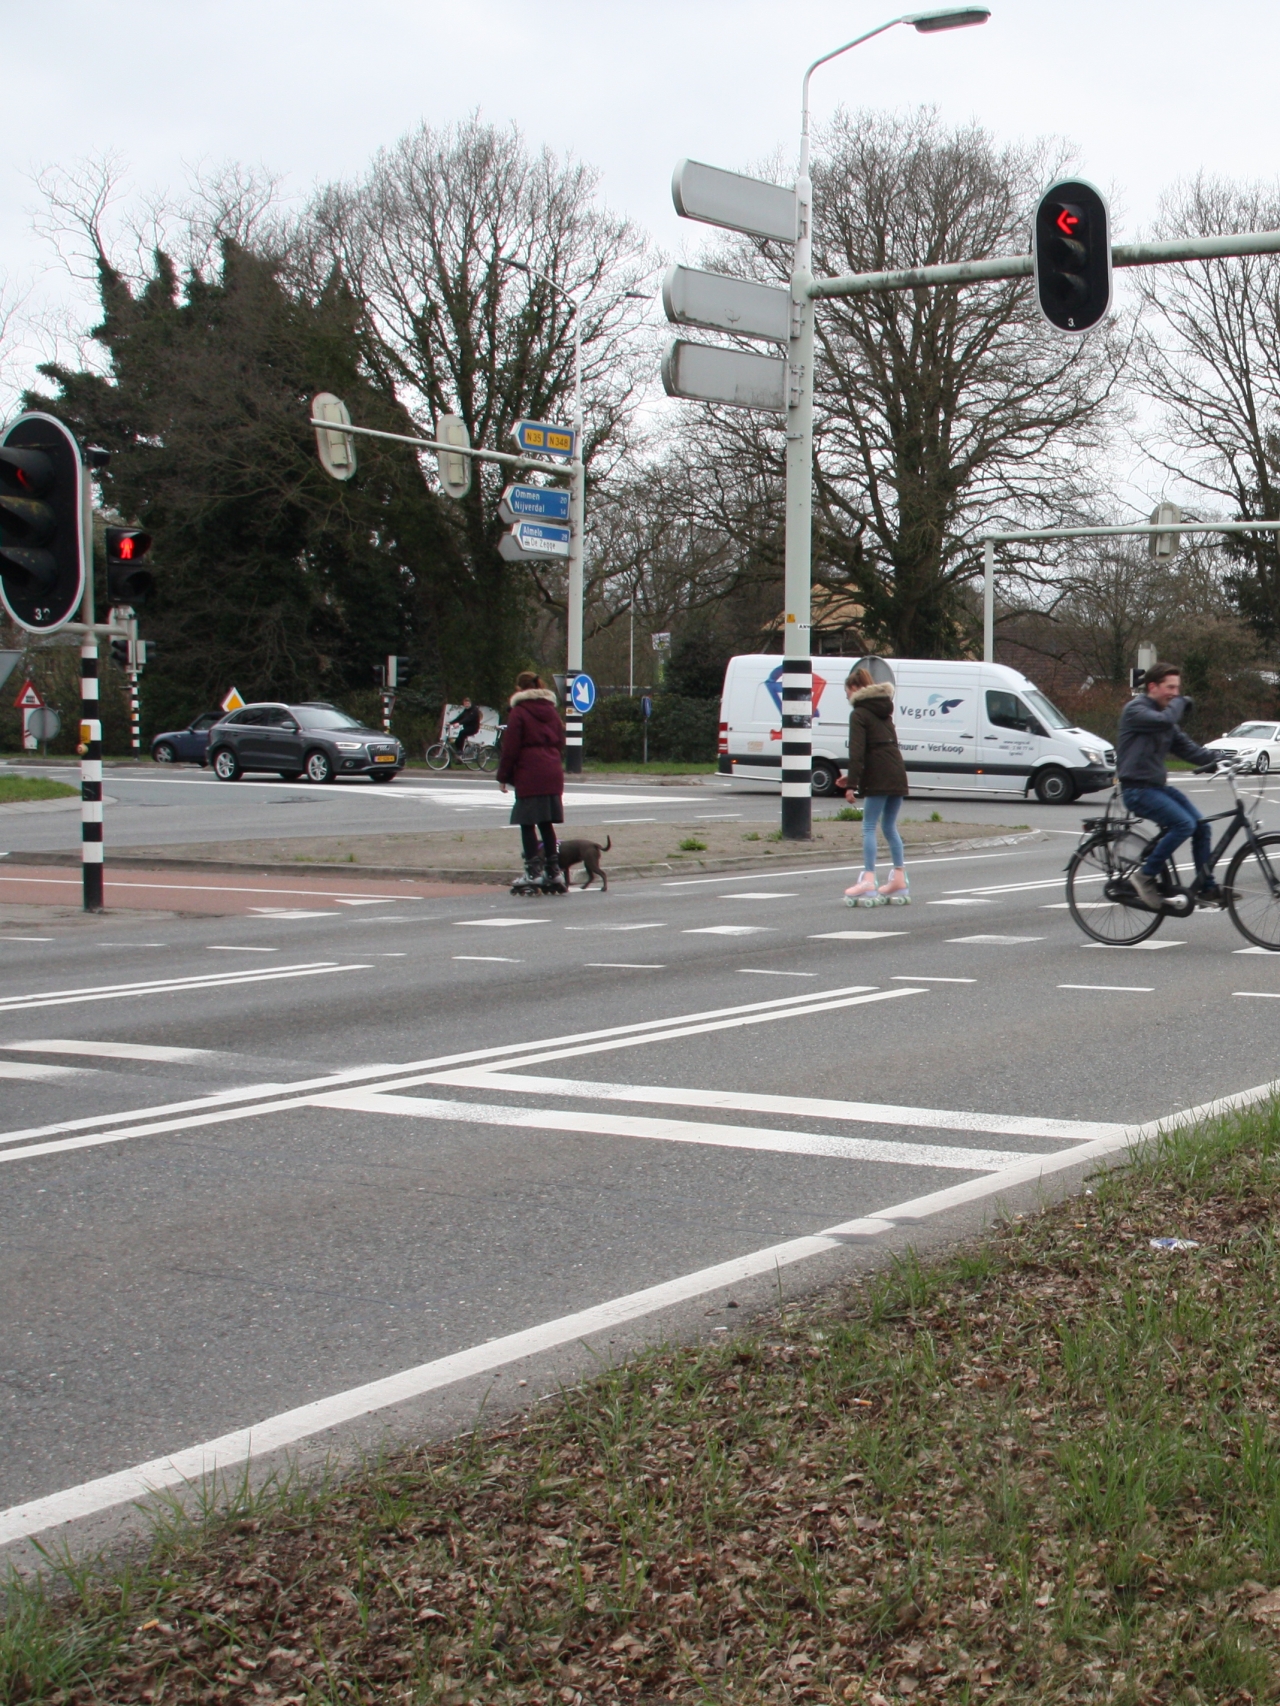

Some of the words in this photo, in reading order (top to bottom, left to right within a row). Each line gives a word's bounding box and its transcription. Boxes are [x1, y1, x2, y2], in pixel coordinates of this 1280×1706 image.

[515, 489, 539, 500] Ommen
[560, 496, 568, 504] 20
[514, 501, 544, 513] Nijverdal
[523, 526, 542, 537] Almelo
[531, 538, 537, 546] De
[539, 539, 556, 552] Zegge
[900, 706, 935, 719] Vegro
[898, 743, 918, 751] huur
[928, 744, 963, 754] Verkoop
